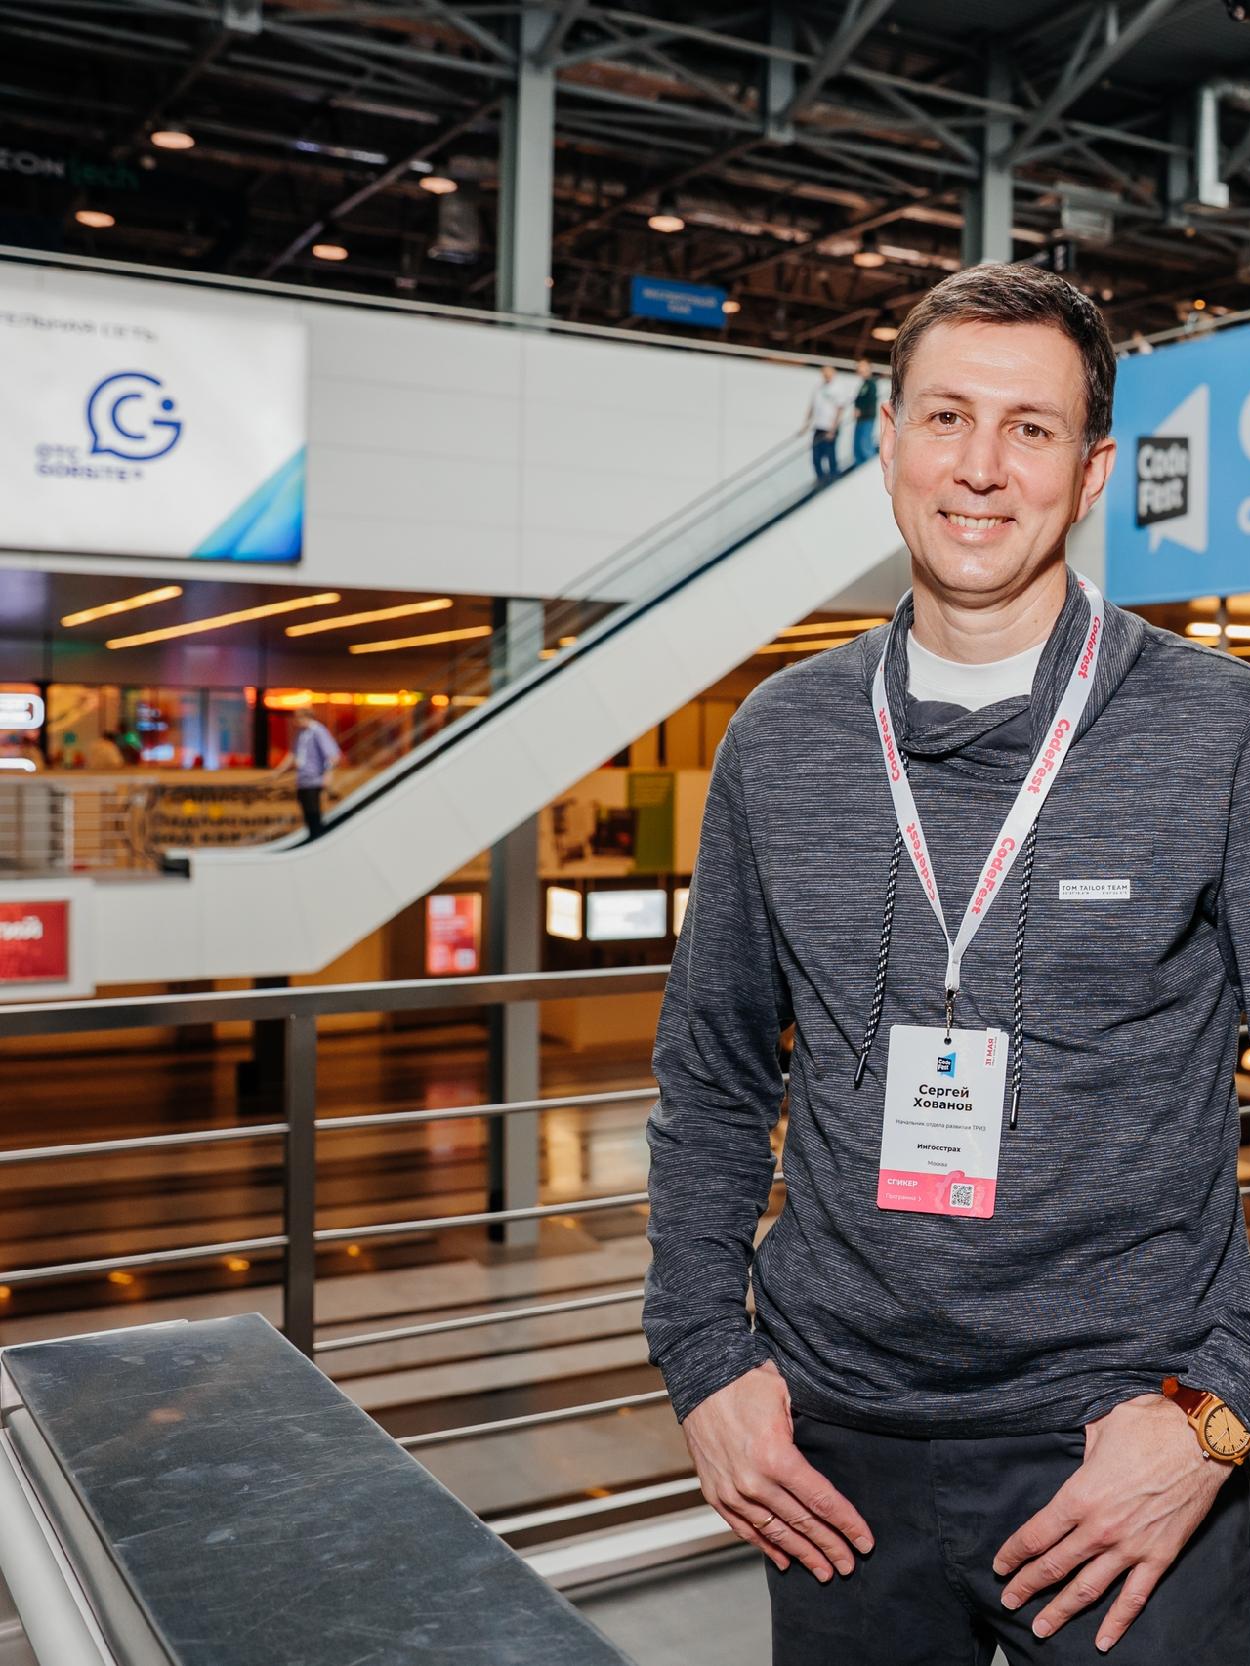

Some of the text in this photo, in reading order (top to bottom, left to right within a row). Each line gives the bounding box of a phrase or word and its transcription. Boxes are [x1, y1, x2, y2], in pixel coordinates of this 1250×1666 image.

[1138, 443, 1188, 479] Code
[1138, 478, 1184, 517] Fest
[1078, 616, 1101, 679] CodeFest
[879, 707, 901, 781] CodeFest
[1027, 719, 1071, 794] CodeFest
[907, 822, 936, 901] CodeFest
[971, 837, 1016, 915] CodeFest
[986, 1038, 994, 1057] МАЯ
[913, 1097, 973, 1111] Хованов
[919, 1084, 969, 1098] Сергей
[917, 1143, 961, 1152] Ингосстрах
[887, 1179, 918, 1187] СПИКЕР
